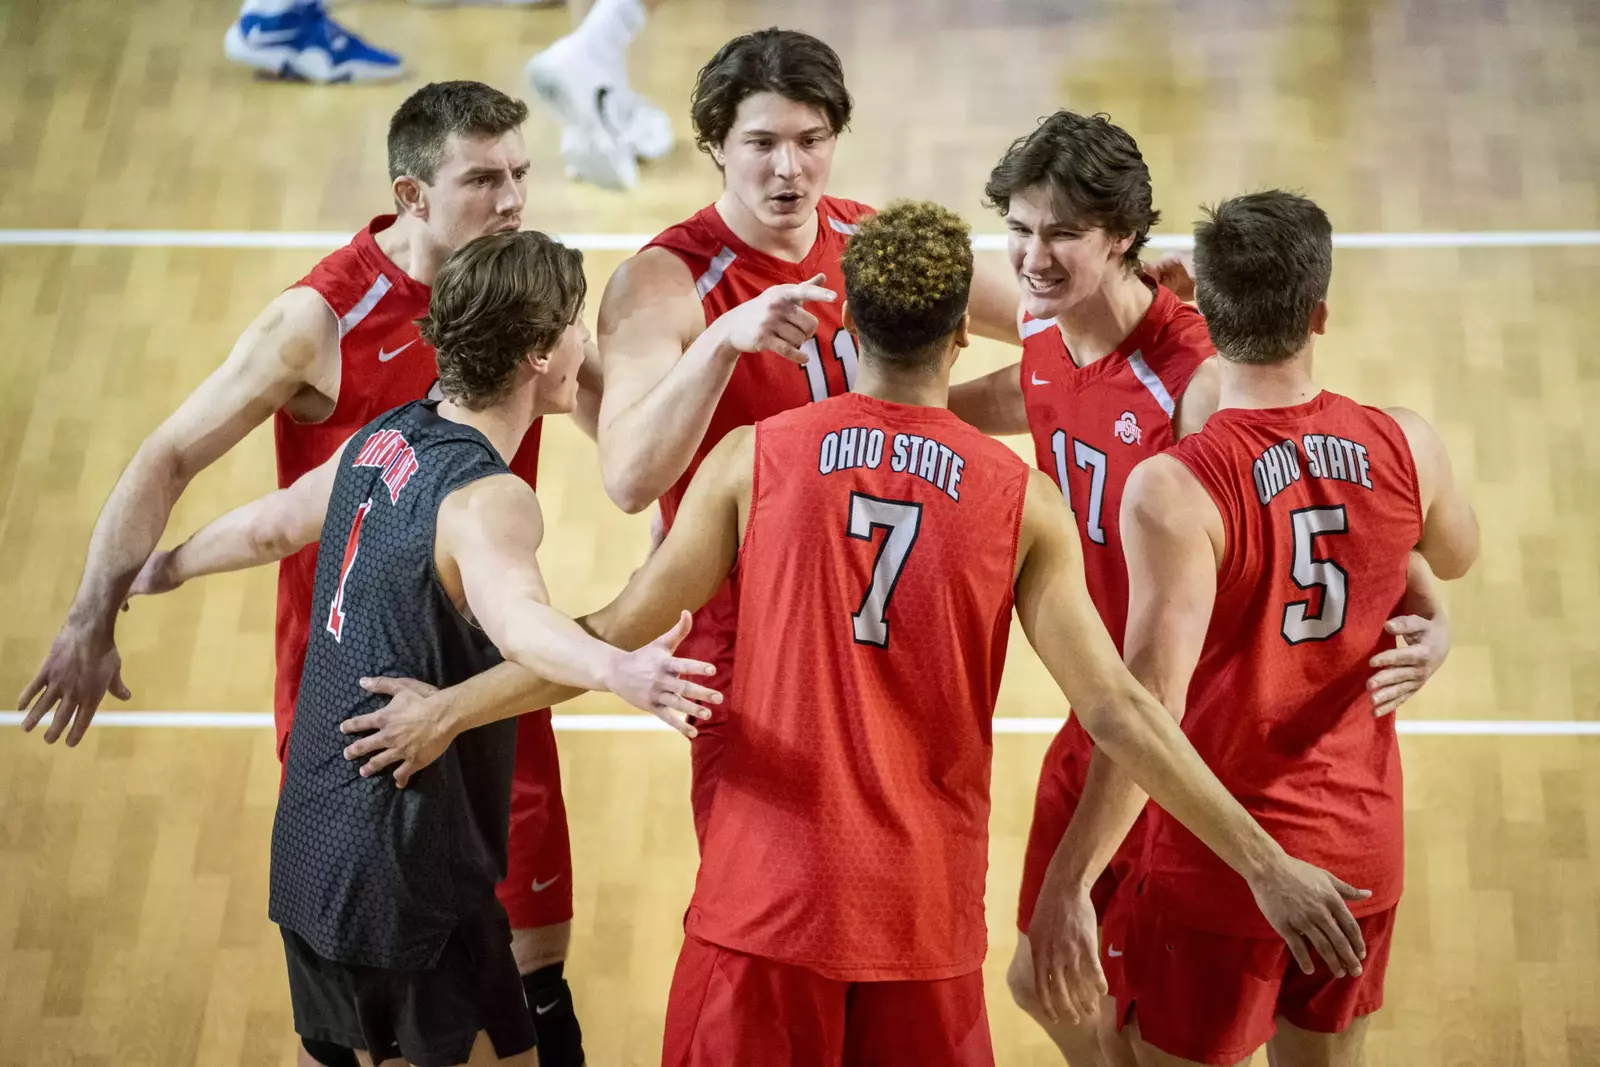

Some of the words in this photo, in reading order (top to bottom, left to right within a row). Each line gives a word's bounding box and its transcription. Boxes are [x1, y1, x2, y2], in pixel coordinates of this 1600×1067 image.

[818, 427, 885, 475] OHIO
[891, 433, 966, 503] STATE
[1051, 428, 1107, 545] 17
[1252, 438, 1301, 506] OHIO
[1302, 434, 1374, 491] STATE
[846, 490, 924, 650] 7
[1280, 504, 1349, 646] 5
